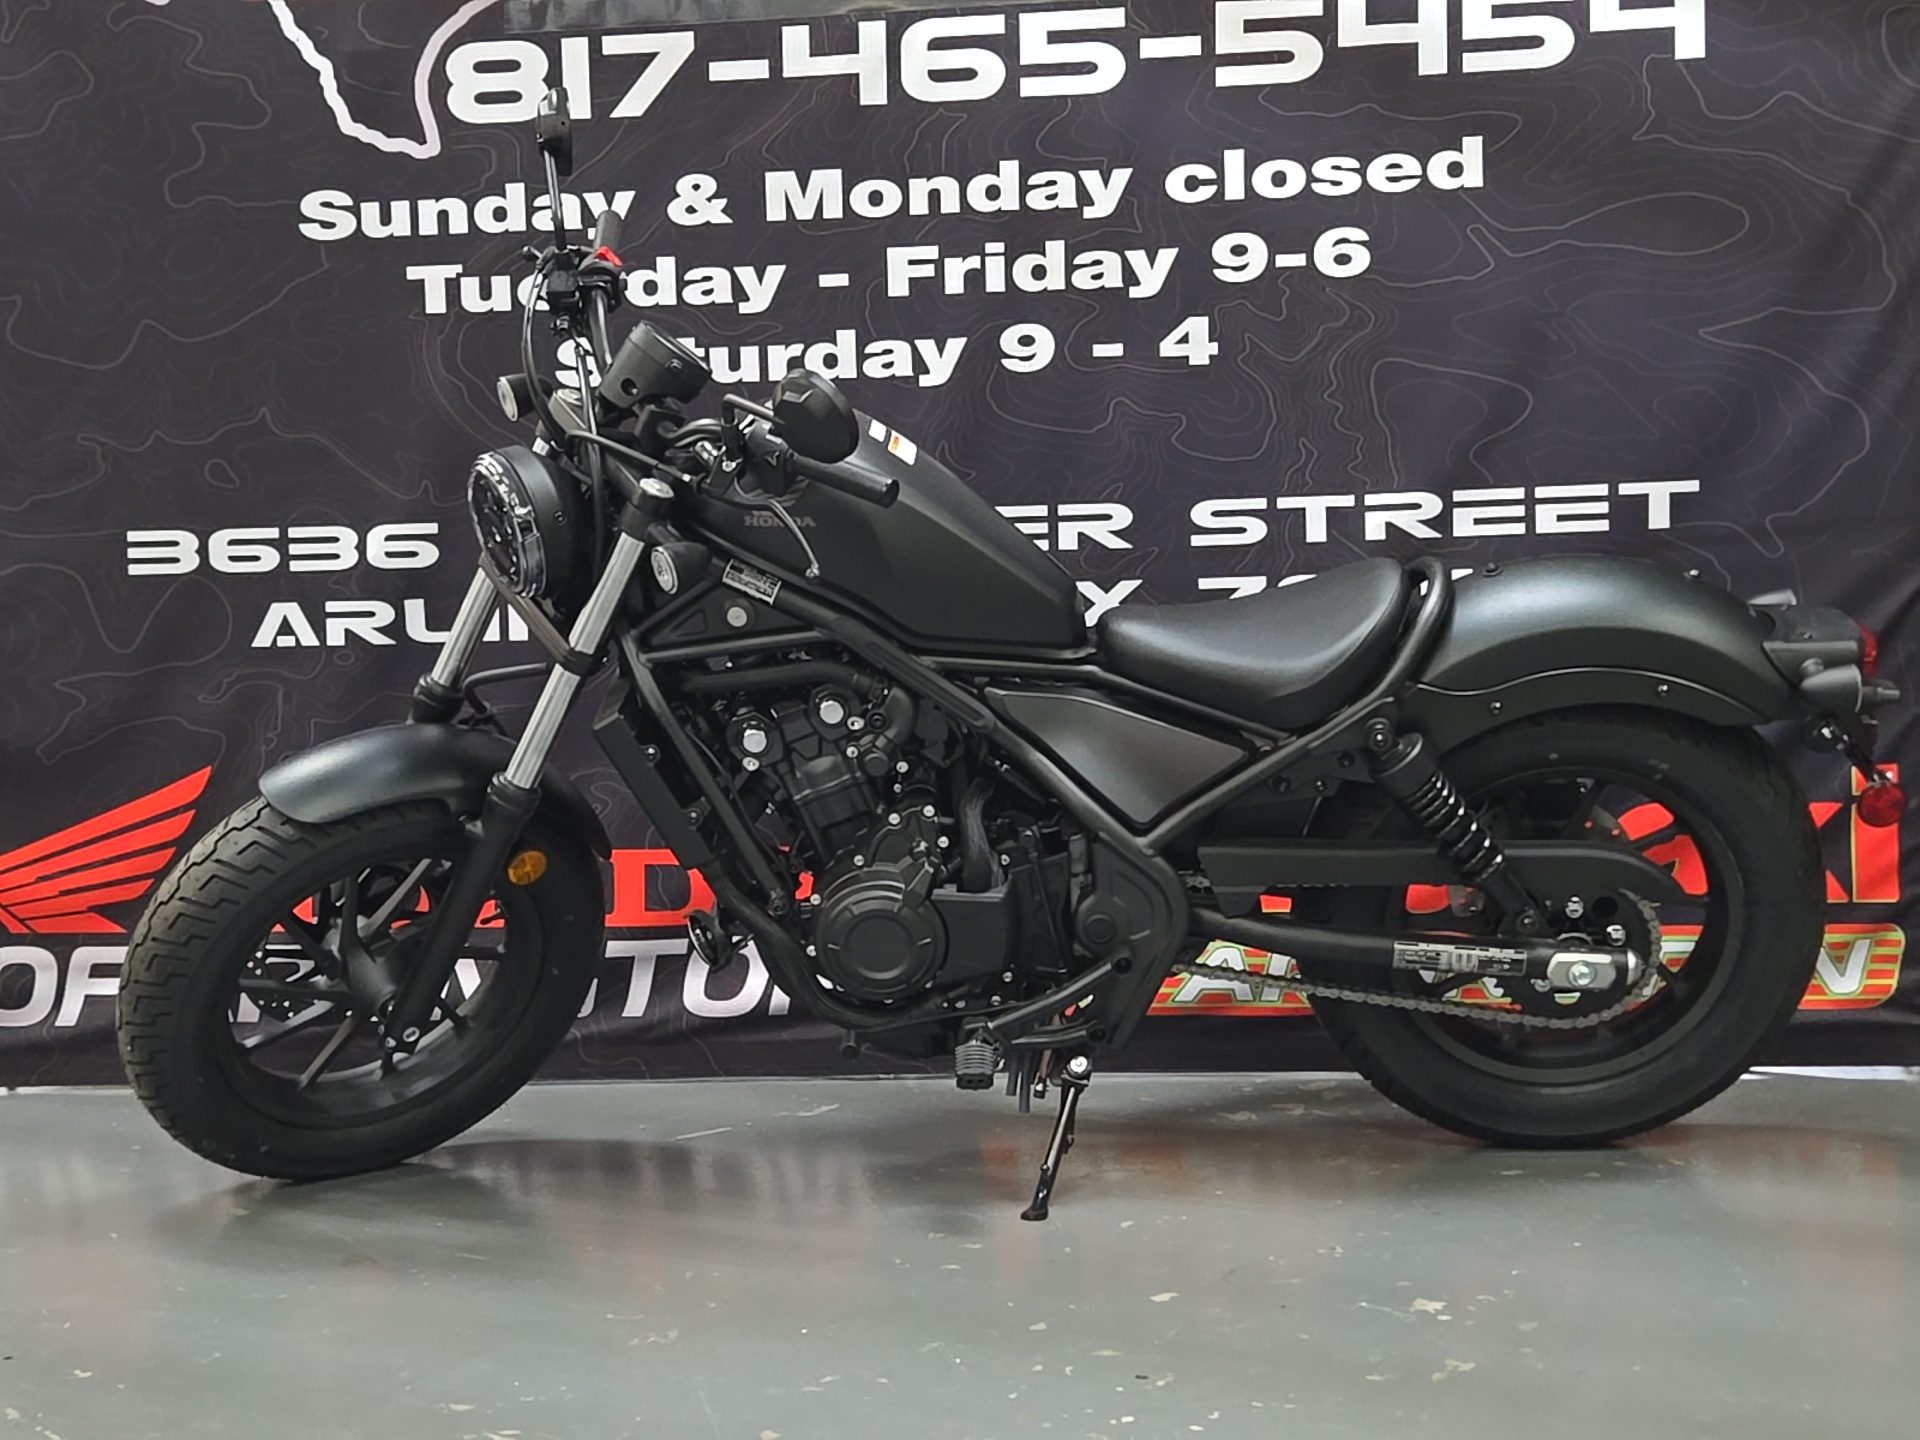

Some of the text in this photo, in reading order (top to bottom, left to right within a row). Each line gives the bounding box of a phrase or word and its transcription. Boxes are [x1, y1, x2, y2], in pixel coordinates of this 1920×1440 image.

[445, 0, 1706, 124] 817-465-5454
[298, 135, 1484, 241] Sunday & Monday closed
[818, 273, 850, 288] -
[886, 239, 1179, 299] Friday
[1211, 226, 1371, 283] 9-6
[999, 323, 1056, 373] 9
[1092, 342, 1124, 357] -
[1159, 316, 1219, 366] 4
[126, 522, 440, 576] 3636
[1190, 479, 1700, 547] STREET
